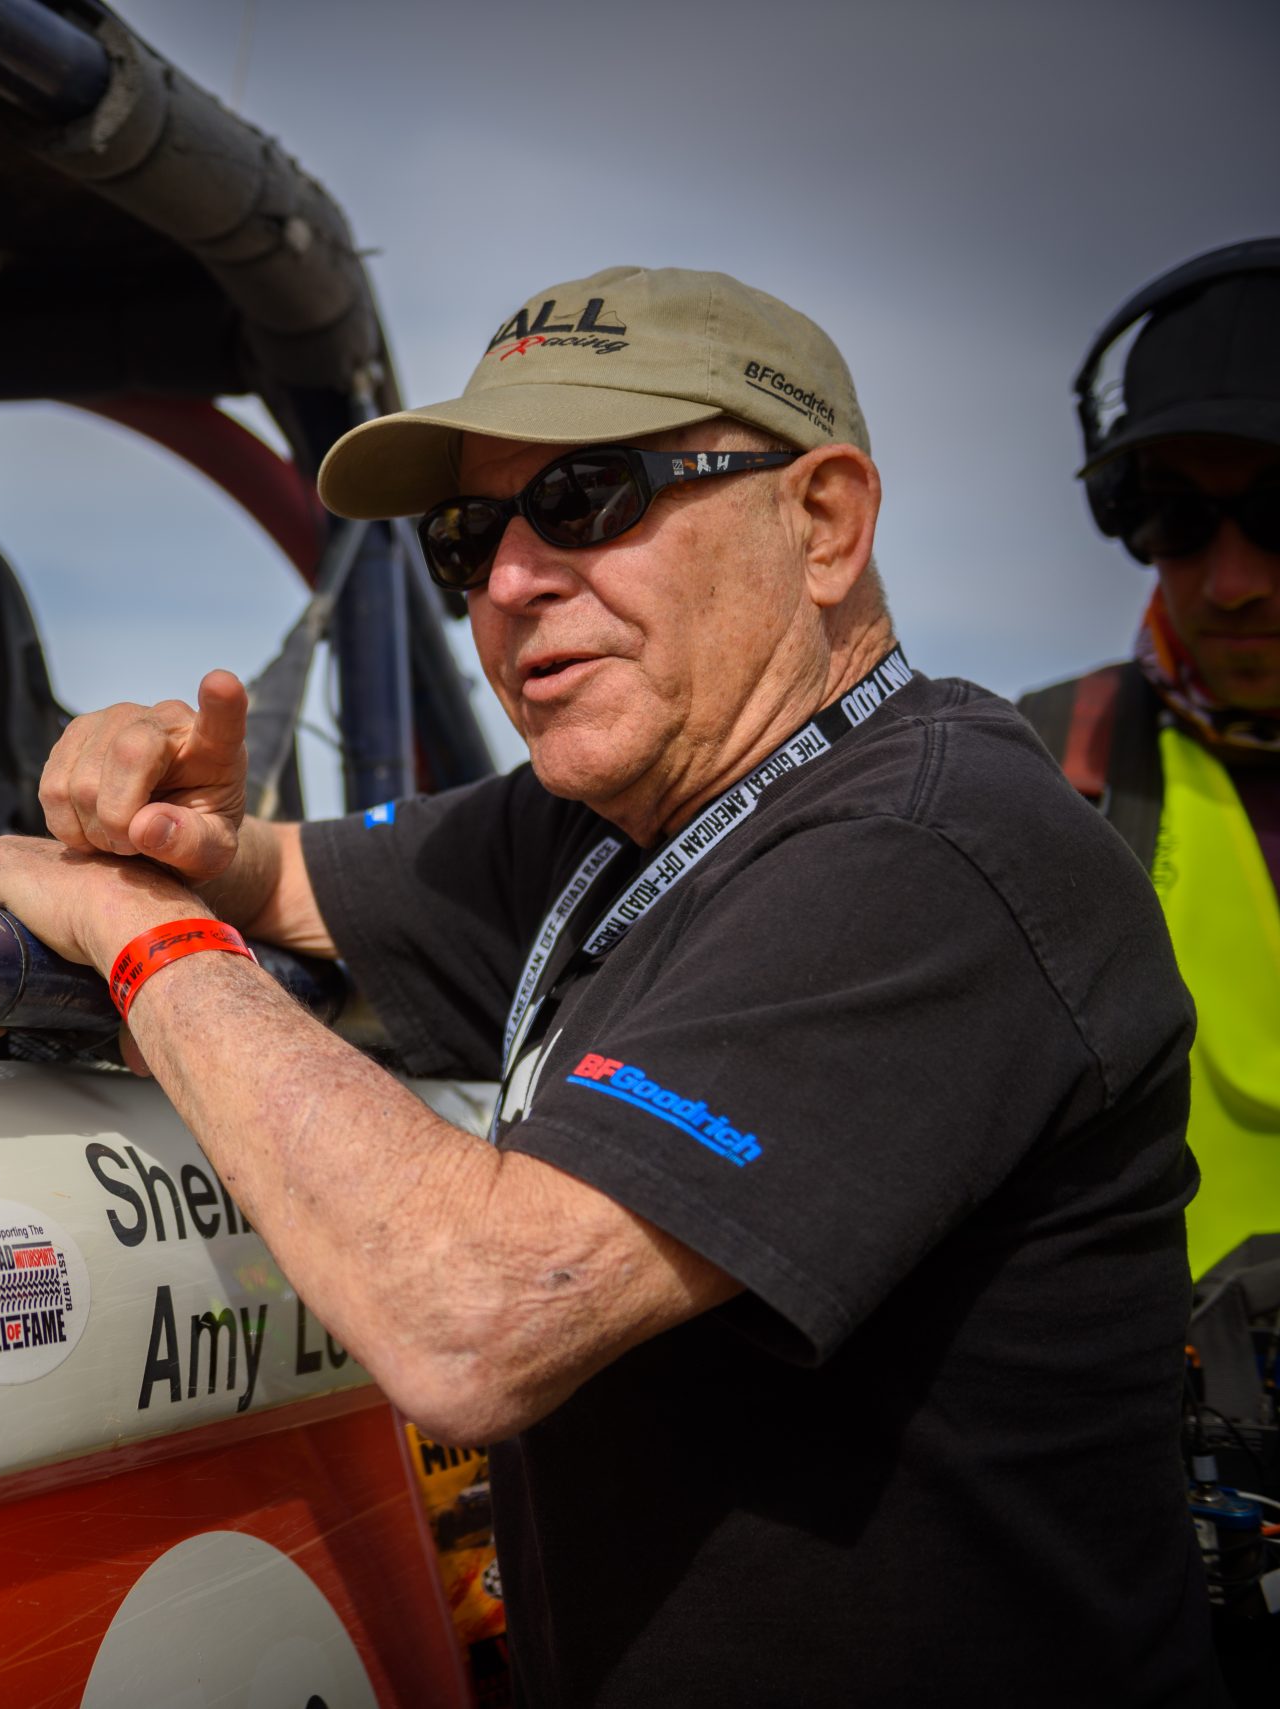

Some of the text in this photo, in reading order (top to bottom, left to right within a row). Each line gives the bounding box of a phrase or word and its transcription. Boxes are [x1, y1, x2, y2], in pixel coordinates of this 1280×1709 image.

[486, 334, 630, 361] Racing
[744, 361, 834, 425] BFGoodrich
[807, 410, 834, 437] Tires
[589, 730, 826, 954] THE GREAT AMERICAN OFF-ROAD RACE
[511, 955, 545, 1024] AMERICAN
[540, 878, 588, 950] OFF-ROAD
[582, 841, 618, 876] RACE
[118, 953, 132, 975] DAY
[130, 961, 143, 980] VIP
[573, 1053, 762, 1162] BFGoodrich
[28, 1225, 44, 1236] The
[13, 1247, 57, 1270] MOTORSPORTS
[57, 1252, 73, 1312] EST. 1978
[7, 1323, 22, 1343] OF
[22, 1309, 67, 1348] FAME
[138, 1285, 268, 1413] Amy
